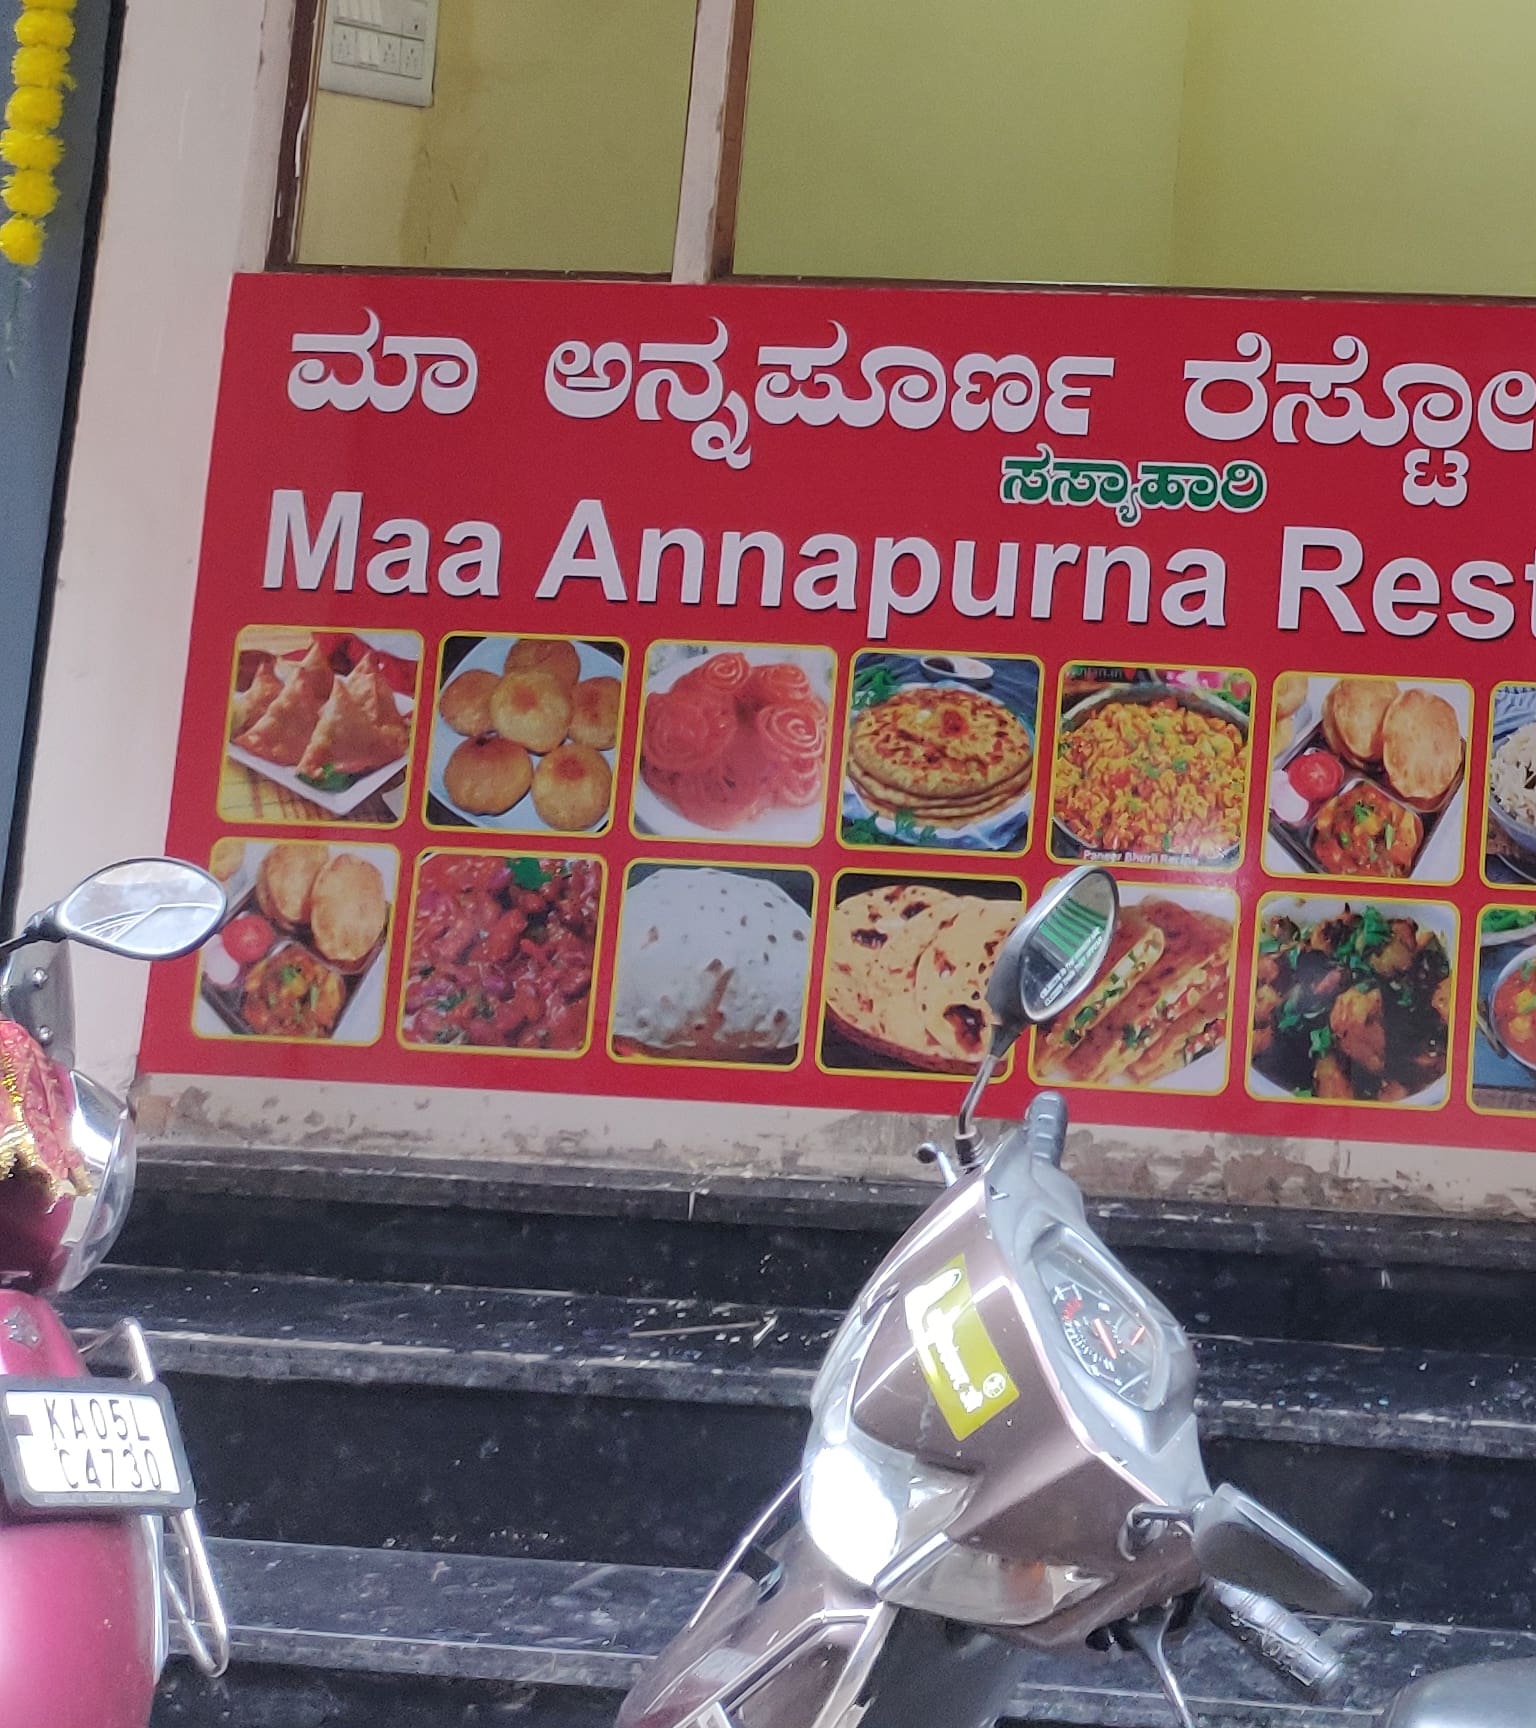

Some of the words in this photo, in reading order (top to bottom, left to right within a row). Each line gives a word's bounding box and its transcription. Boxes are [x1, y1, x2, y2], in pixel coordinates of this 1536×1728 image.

[286, 309, 479, 415] ಮಾ
[544, 317, 1116, 470] ಅನ್ನಪೂರ್ಣ
[1000, 443, 1267, 527] ಸಸ್ಯಾಹಾರಿ
[262, 489, 502, 598] Maa
[534, 499, 1227, 640] Annapurna
